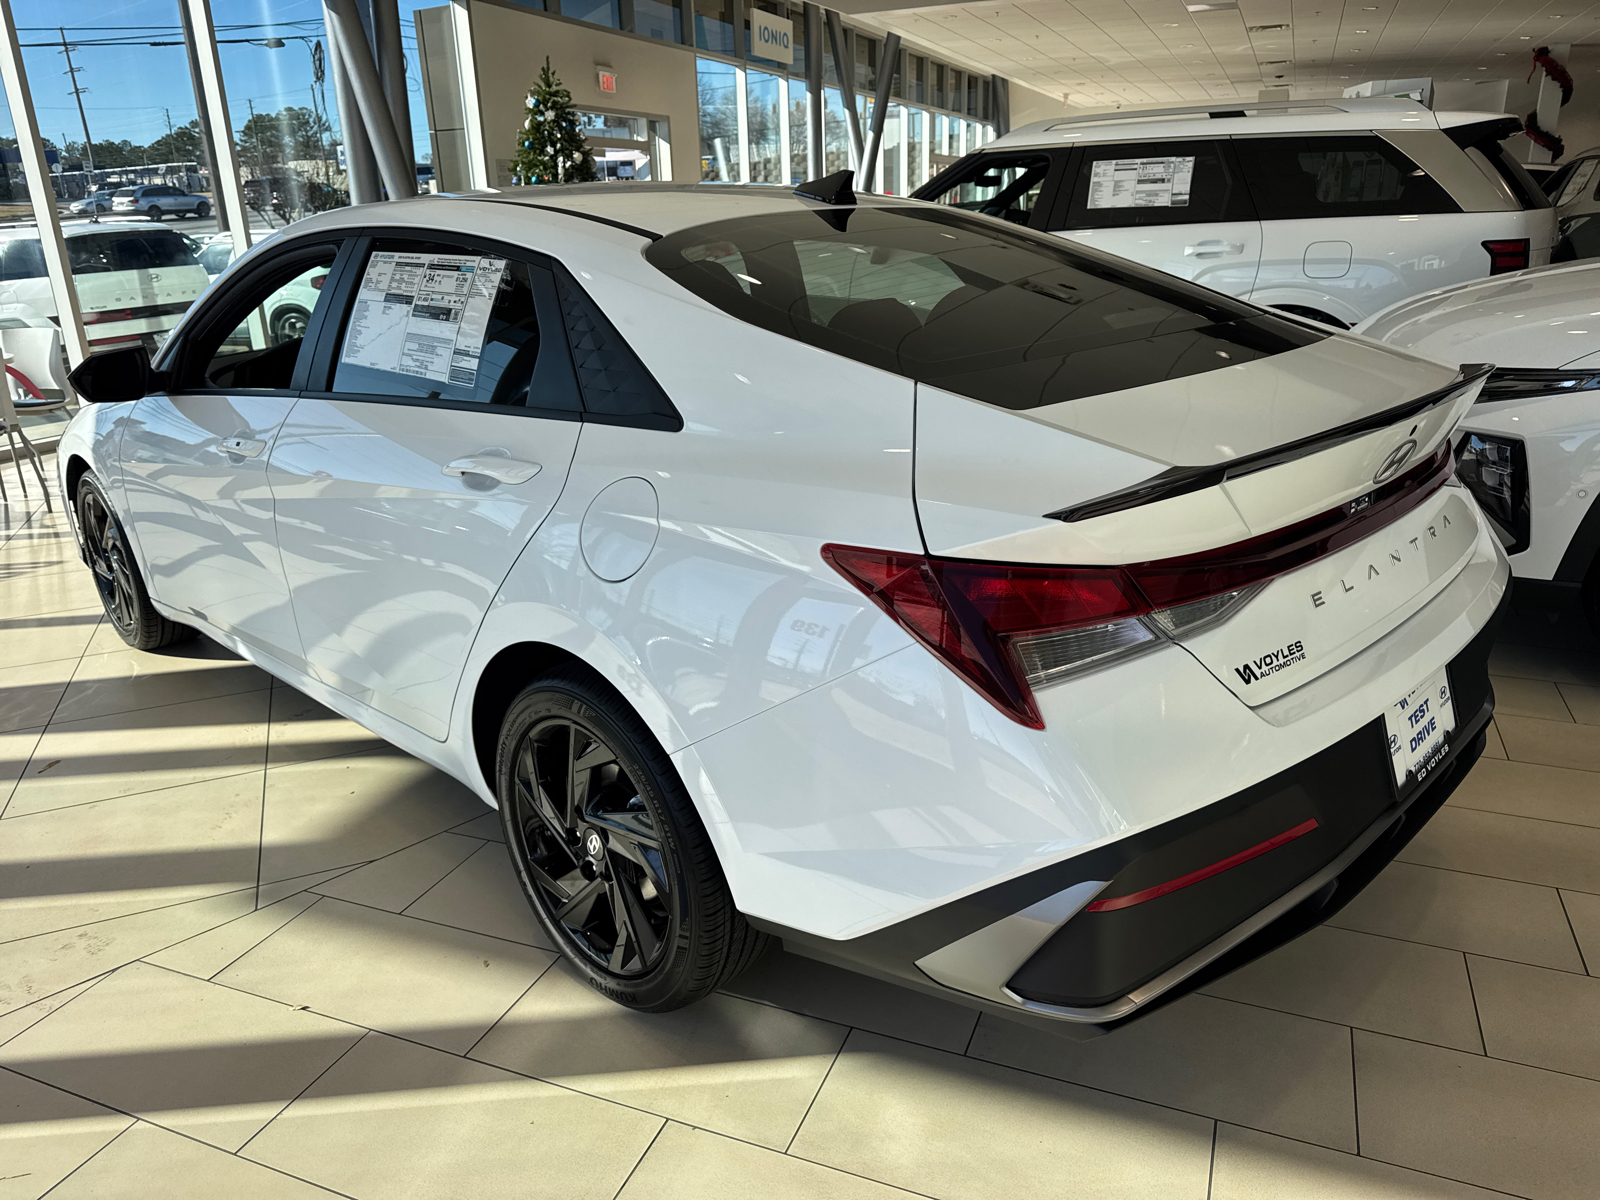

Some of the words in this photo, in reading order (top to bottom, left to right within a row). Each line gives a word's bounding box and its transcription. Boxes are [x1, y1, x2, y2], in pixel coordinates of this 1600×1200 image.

[759, 25, 789, 49] IONIQ
[602, 74, 614, 91] EXIT
[115, 293, 172, 302] SANTA
[1310, 515, 1451, 608] ELANTRA
[1253, 640, 1303, 670] VOYLES
[1260, 652, 1306, 679] AUTOMOTIVE
[1408, 698, 1430, 729] TEST
[1409, 716, 1437, 753] DRIVE
[1417, 768, 1427, 781] ED
[1426, 744, 1449, 771] VOYLES
[589, 976, 639, 1003] KUMHO
